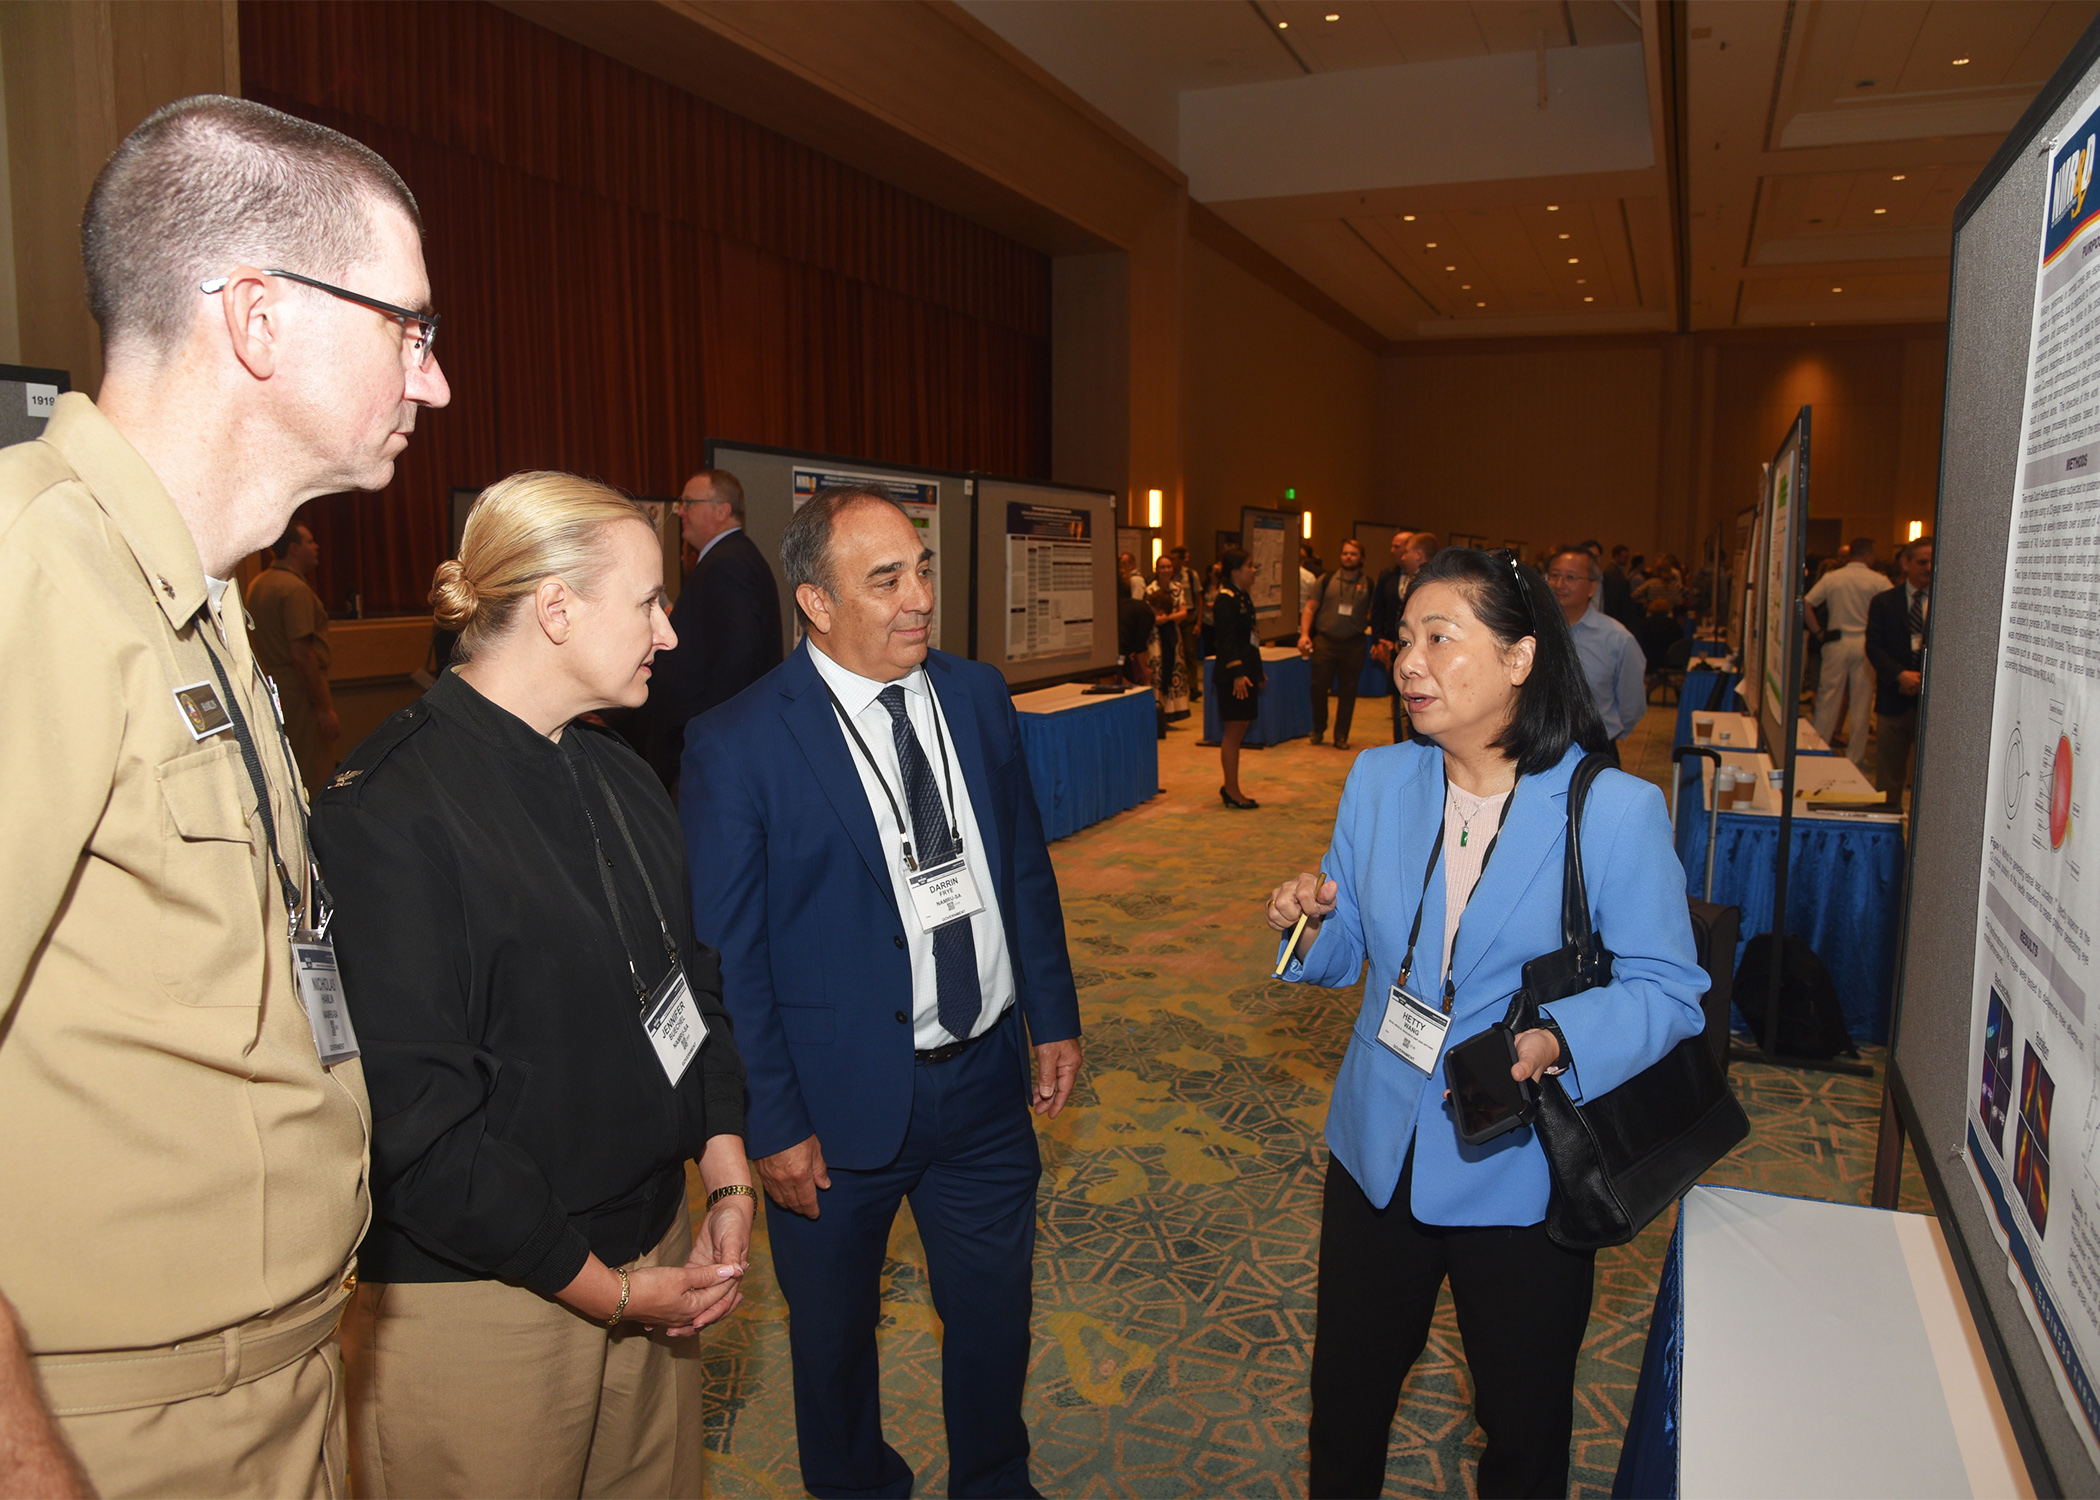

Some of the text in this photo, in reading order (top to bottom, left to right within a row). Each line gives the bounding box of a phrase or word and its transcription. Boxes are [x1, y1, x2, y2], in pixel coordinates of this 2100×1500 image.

[32, 396, 55, 406] 1919
[929, 877, 959, 894] DARRIN
[939, 888, 954, 897] FRYE
[2019, 927, 2038, 958] RESULTS
[662, 1000, 686, 1039] JENNIFER
[1402, 1012, 1426, 1030] HETTY
[1403, 1022, 1420, 1036] WANG
[2034, 1282, 2071, 1364] READINESS
